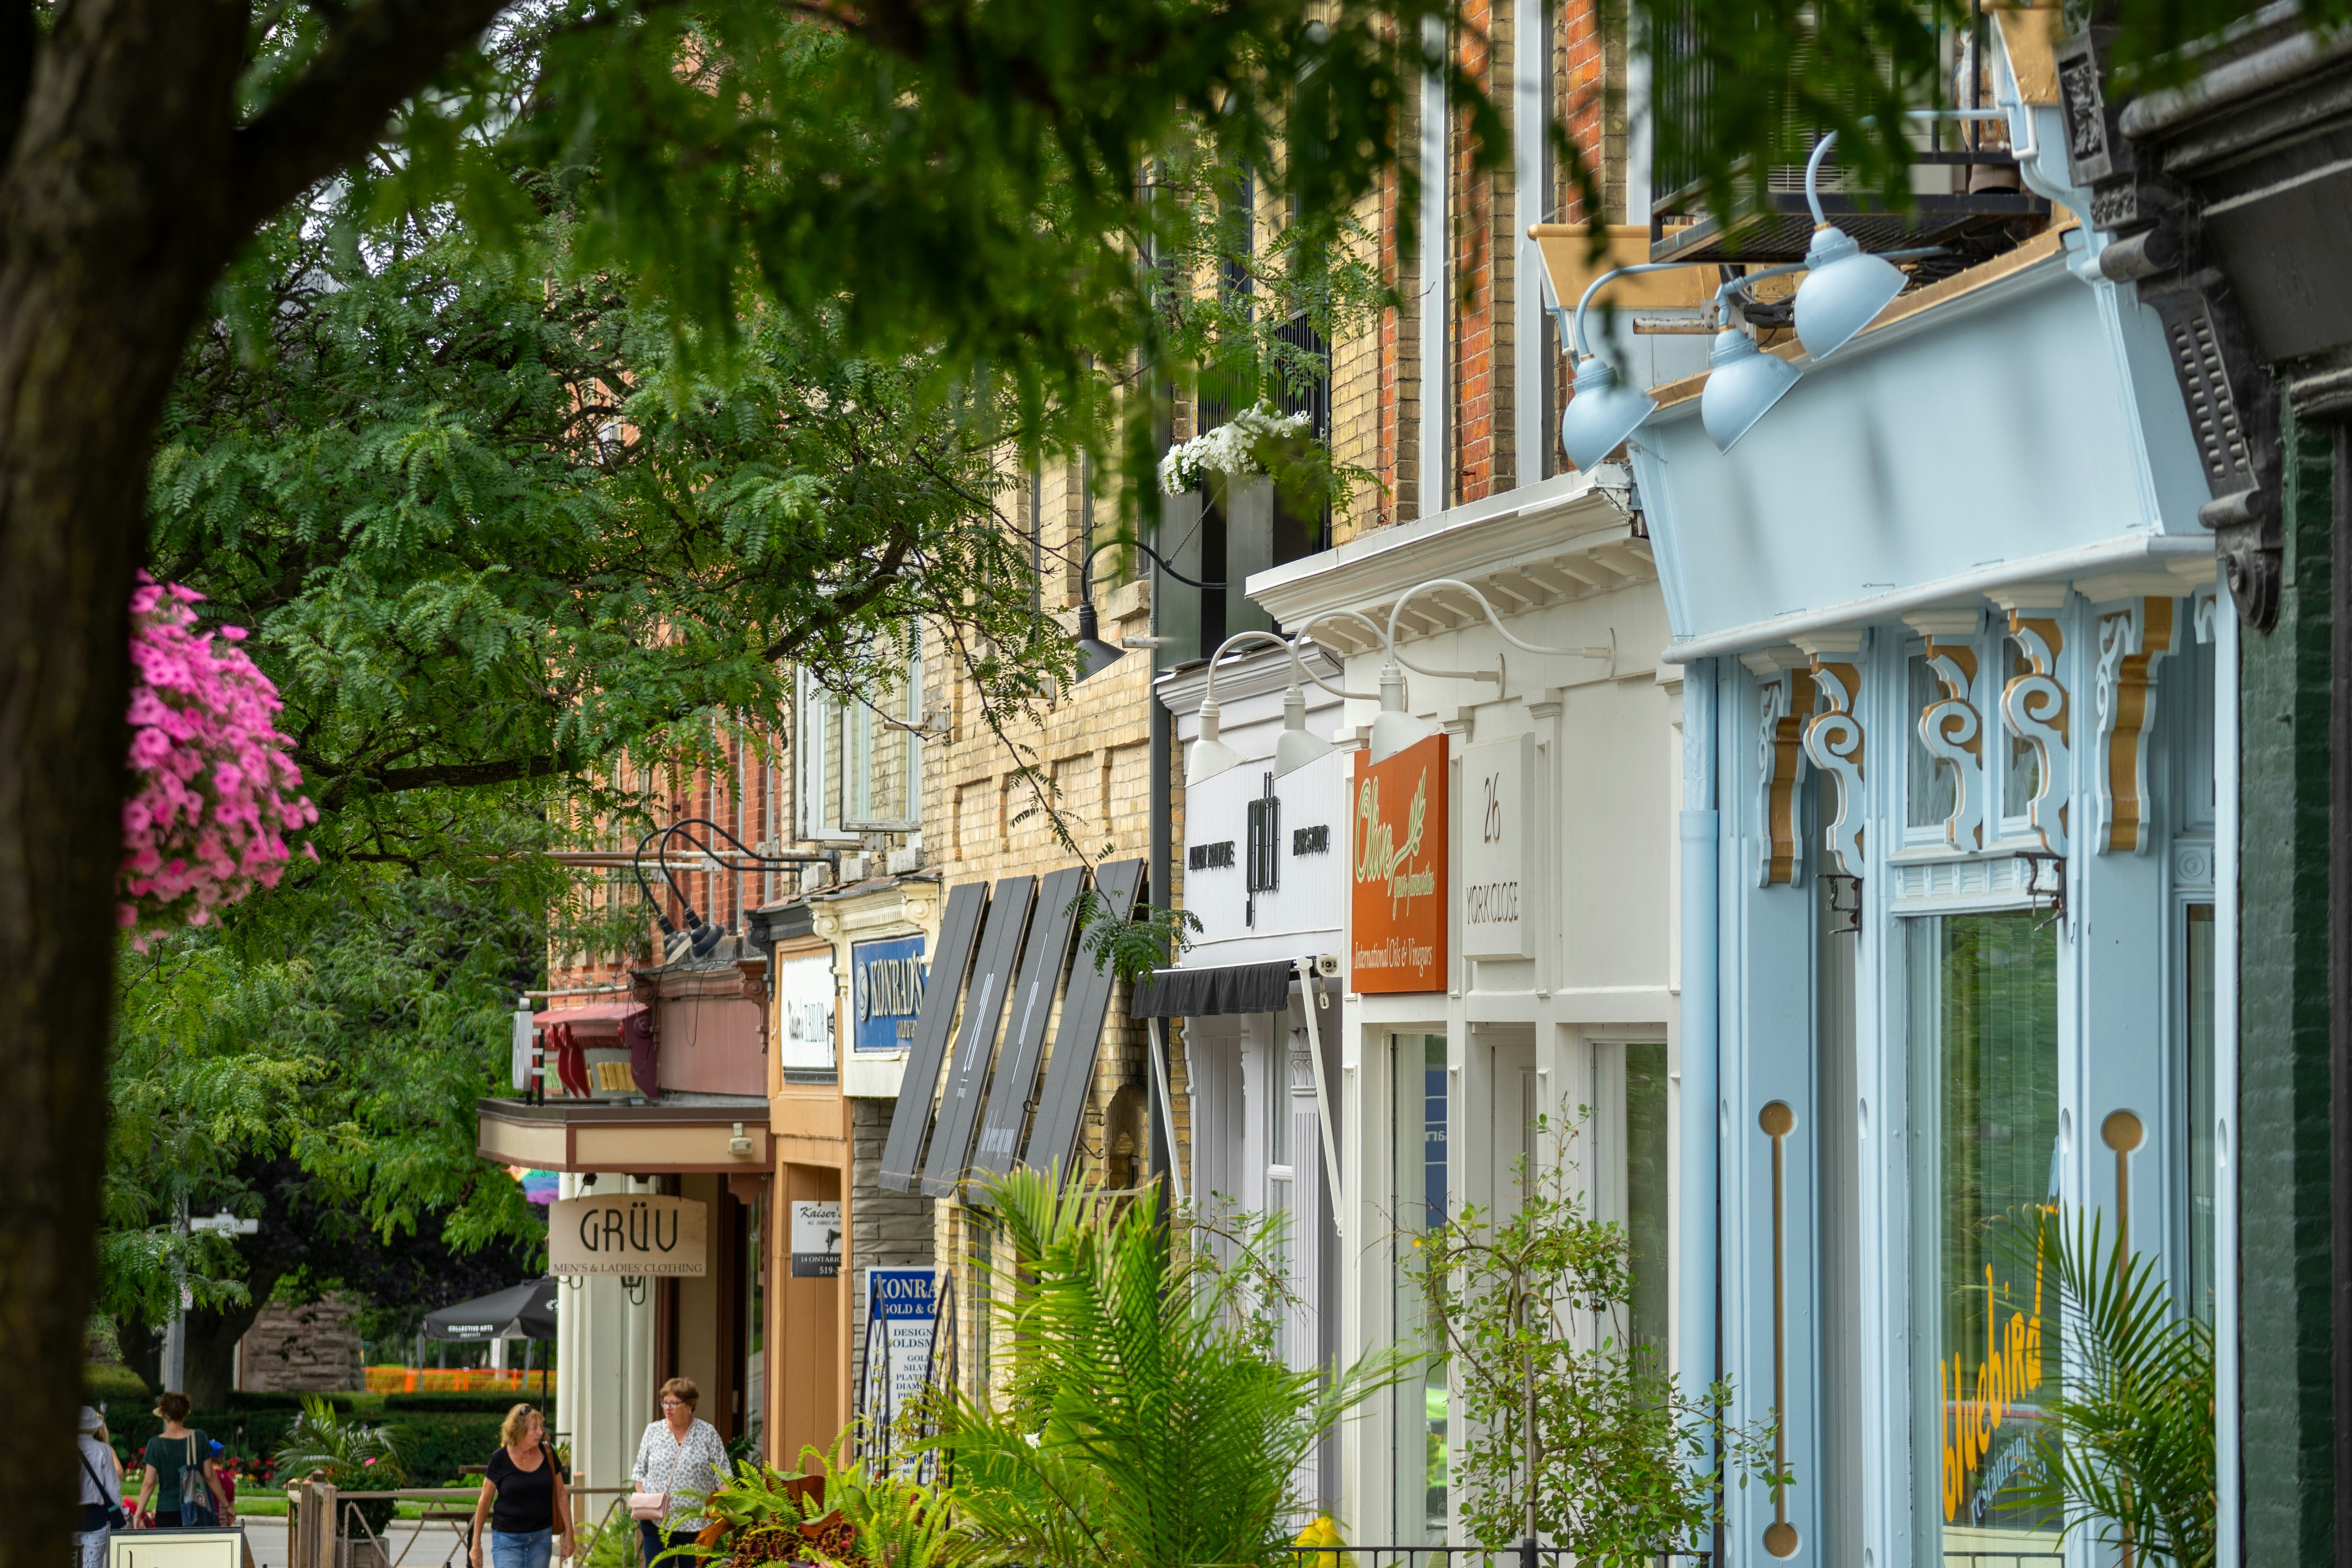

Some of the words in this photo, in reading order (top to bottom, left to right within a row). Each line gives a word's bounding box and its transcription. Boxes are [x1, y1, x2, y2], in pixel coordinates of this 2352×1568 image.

[1484, 772, 1500, 845] 26
[1355, 775, 1394, 897] Olive
[1392, 873, 1407, 921] your
[1406, 856, 1435, 917] favourites
[1466, 885, 1490, 925] YORK
[1490, 882, 1519, 924] CLOSE
[870, 950, 924, 1016] KONRAD'S
[1354, 937, 1389, 969] International
[1389, 936, 1400, 968] Oils
[1401, 939, 1407, 967] &
[1408, 938, 1432, 977] Vinegars
[804, 1001, 826, 1042] TAILOR
[554, 1263, 588, 1272] MEN'S
[591, 1263, 598, 1272] &
[601, 1263, 641, 1272] LADIES'
[644, 1263, 702, 1272] CLOTHING
[915, 1303, 925, 1314] &
[1970, 1427, 2028, 1530] restaurant
